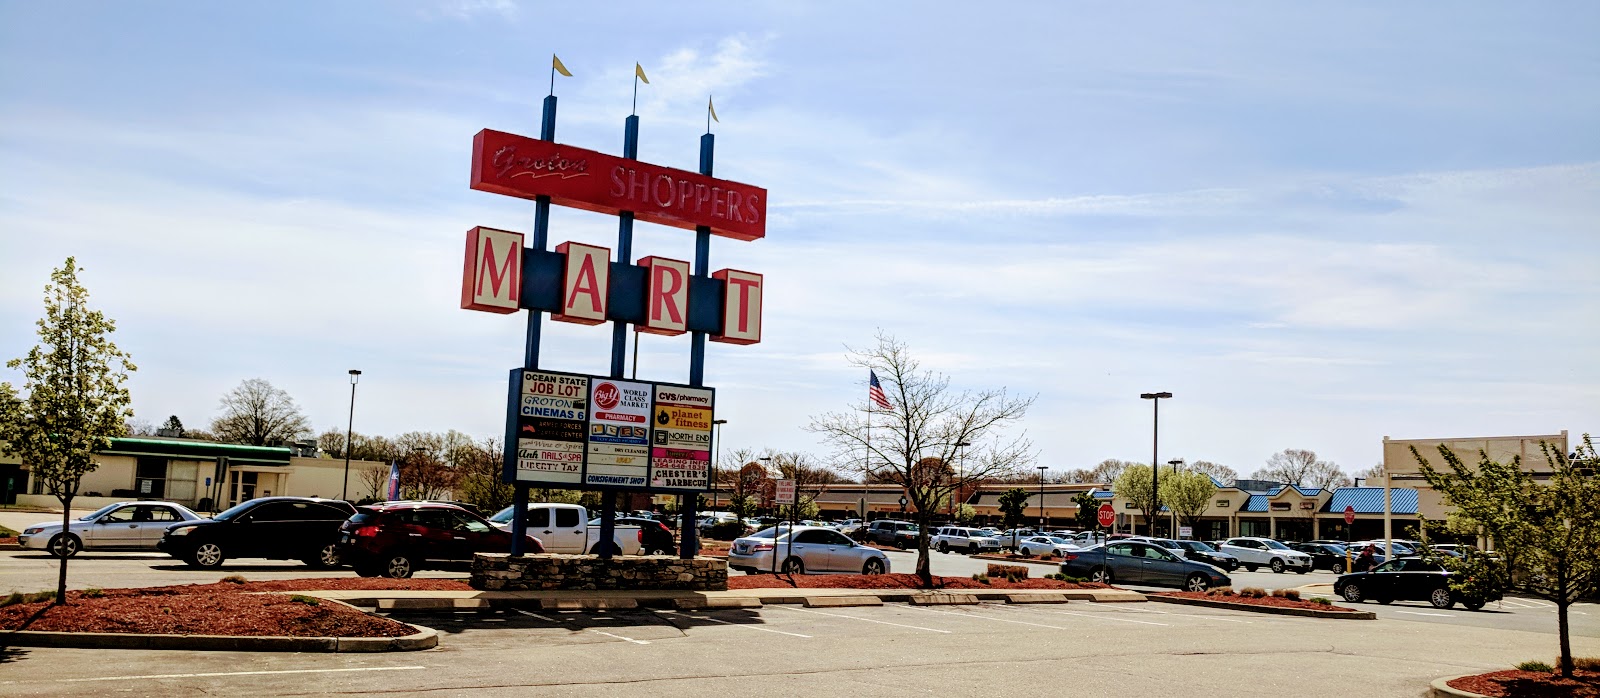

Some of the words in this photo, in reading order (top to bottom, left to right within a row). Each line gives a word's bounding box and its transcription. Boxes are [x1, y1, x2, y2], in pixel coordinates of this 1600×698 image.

[492, 145, 590, 178] Groton
[610, 165, 761, 224] SHOPPERS
[476, 237, 759, 333] MART
[525, 373, 556, 383] OCEAN
[559, 376, 586, 386] STATE
[530, 382, 554, 394] JOB
[558, 384, 581, 396] LOT
[595, 390, 609, 402] Big
[659, 392, 708, 404] CVS/pharmacy
[524, 396, 572, 408] GROTON
[522, 406, 574, 418] CINEMAS
[578, 412, 584, 420] 6
[604, 413, 637, 422] PHARMACY
[672, 410, 703, 420] planet
[676, 418, 708, 428] fitness
[669, 432, 694, 440] NORTH
[518, 450, 539, 459] Anh
[542, 452, 563, 460] NAILS
[588, 475, 629, 484] CONSIGNMENT
[666, 479, 707, 487] BARBECUE
[1100, 510, 1114, 520] STOP
